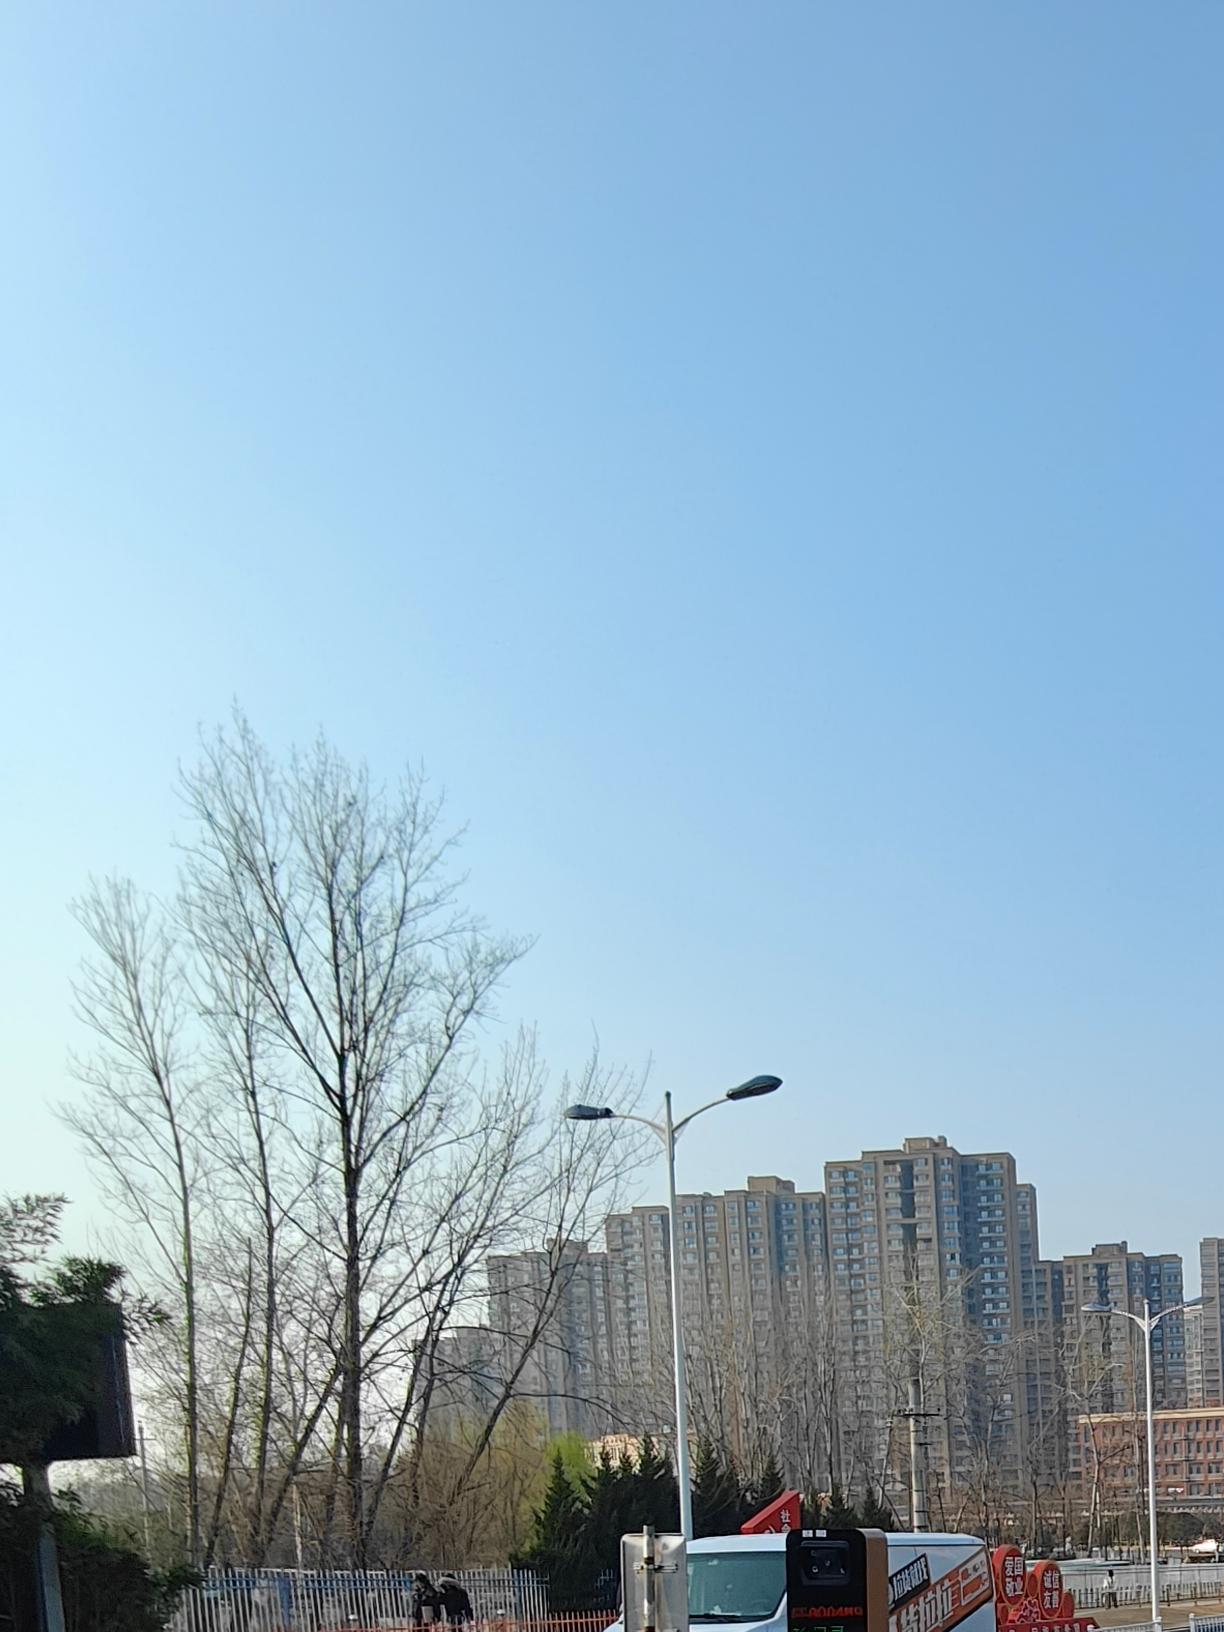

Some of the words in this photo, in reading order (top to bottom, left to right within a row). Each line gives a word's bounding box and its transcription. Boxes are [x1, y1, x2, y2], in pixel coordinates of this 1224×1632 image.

[1005, 1557, 1023, 1576] 爱国
[1005, 1577, 1023, 1597] 敬业
[1044, 1570, 1060, 1589] 诚信
[1044, 1591, 1059, 1608] 友善
